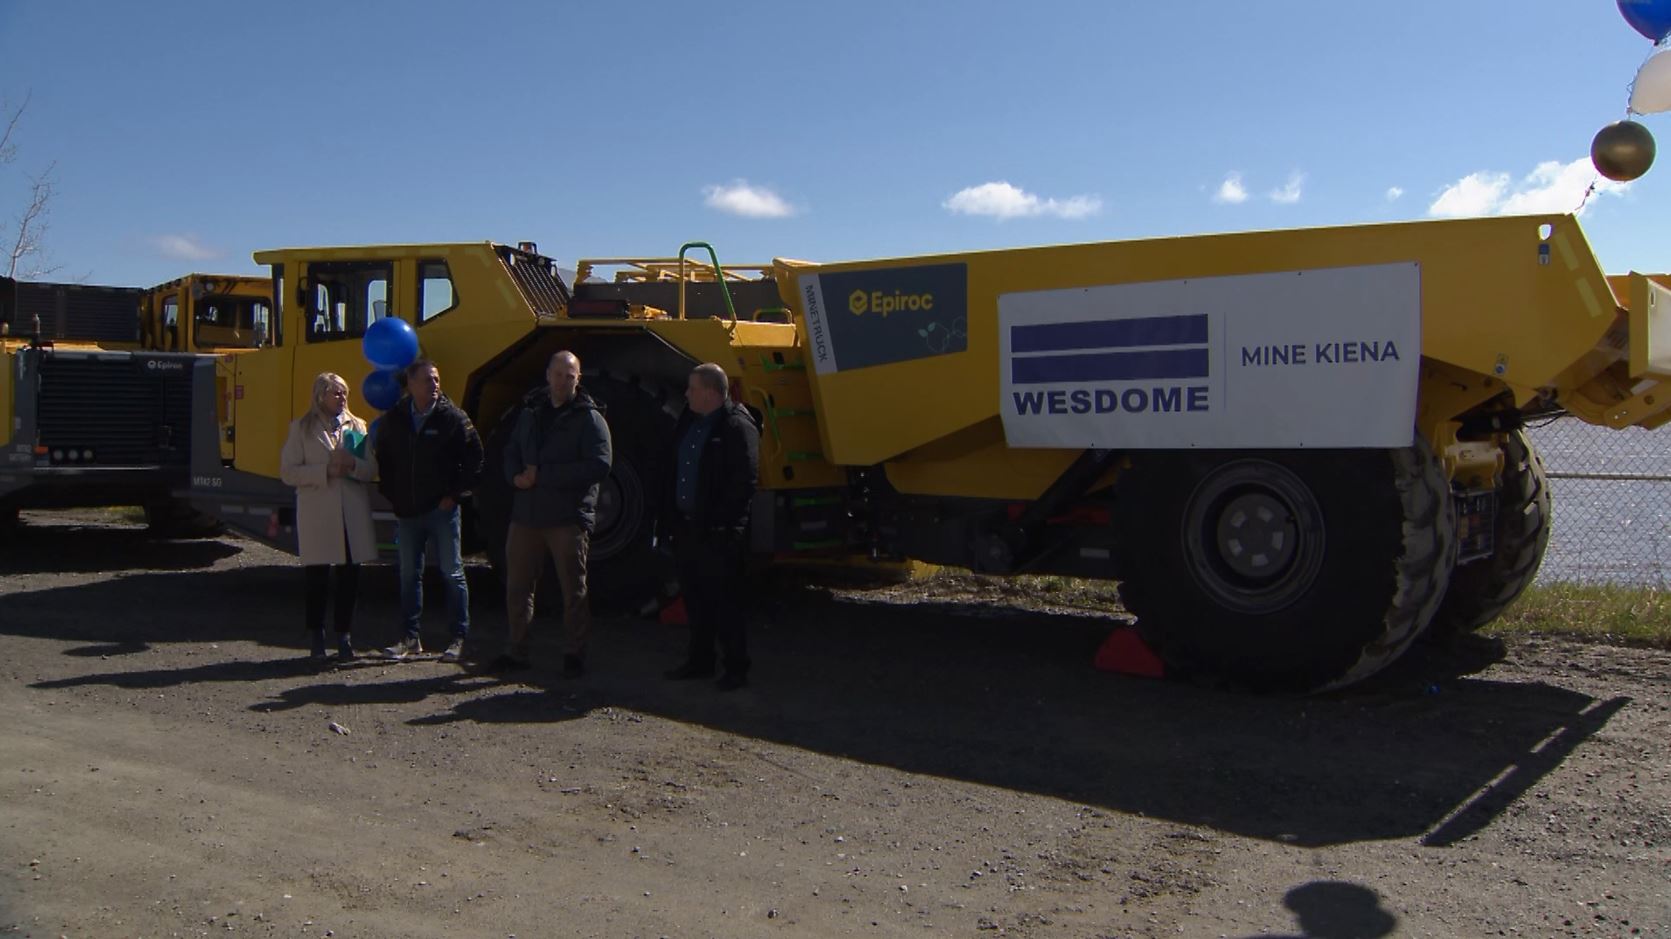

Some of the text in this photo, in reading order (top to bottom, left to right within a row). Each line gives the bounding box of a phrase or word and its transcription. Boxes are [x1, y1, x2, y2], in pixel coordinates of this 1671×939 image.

[871, 290, 933, 317] Epiroc
[805, 284, 828, 363] MINETRUCK
[1241, 340, 1400, 367] MINE KIENA
[1012, 386, 1210, 416] WESDOME
